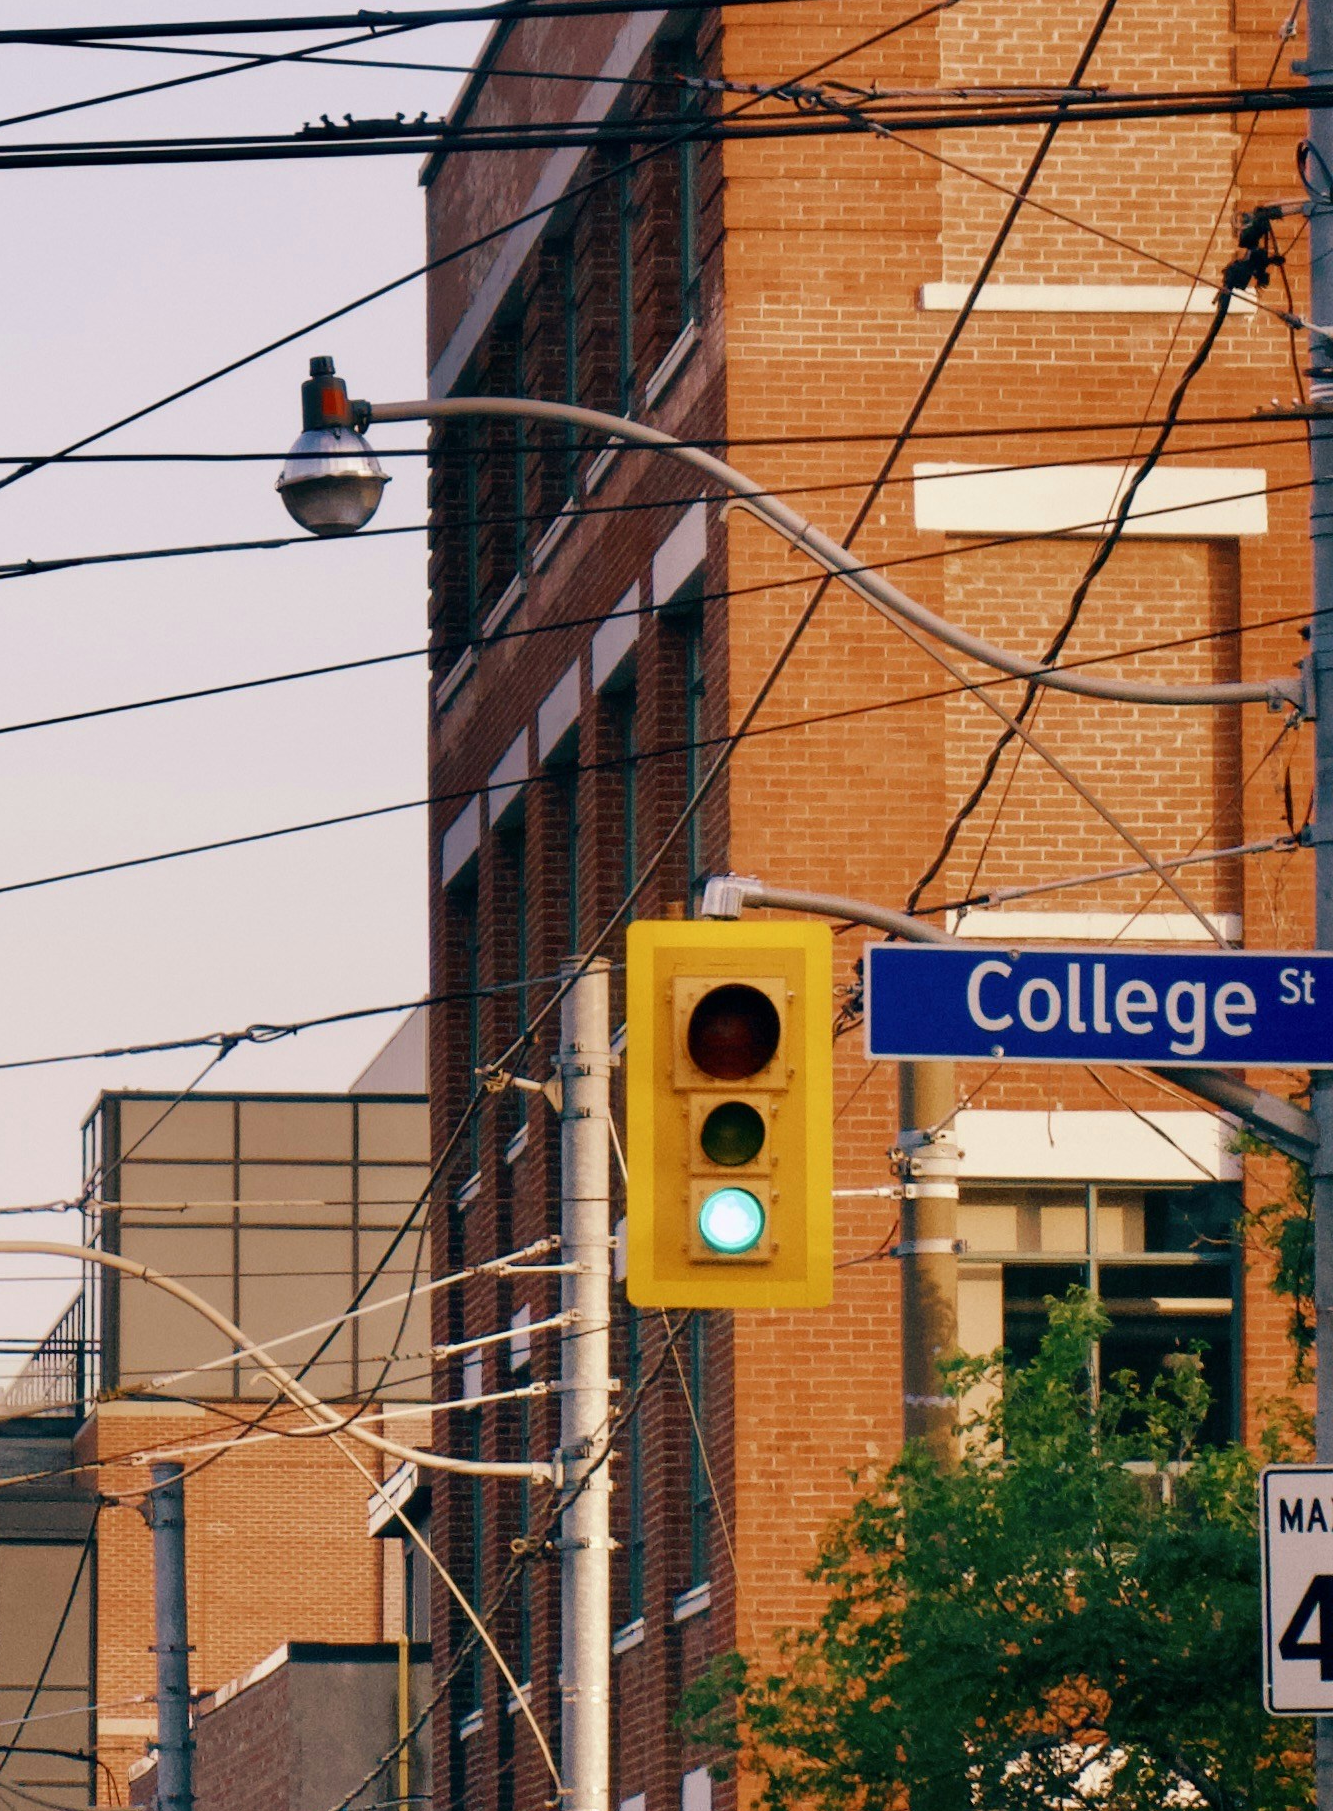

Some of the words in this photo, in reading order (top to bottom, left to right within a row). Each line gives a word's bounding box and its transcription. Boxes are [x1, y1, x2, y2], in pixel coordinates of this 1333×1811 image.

[966, 960, 1258, 1056] College
[1279, 967, 1316, 1006] St
[1279, 1497, 1333, 1534] MA
